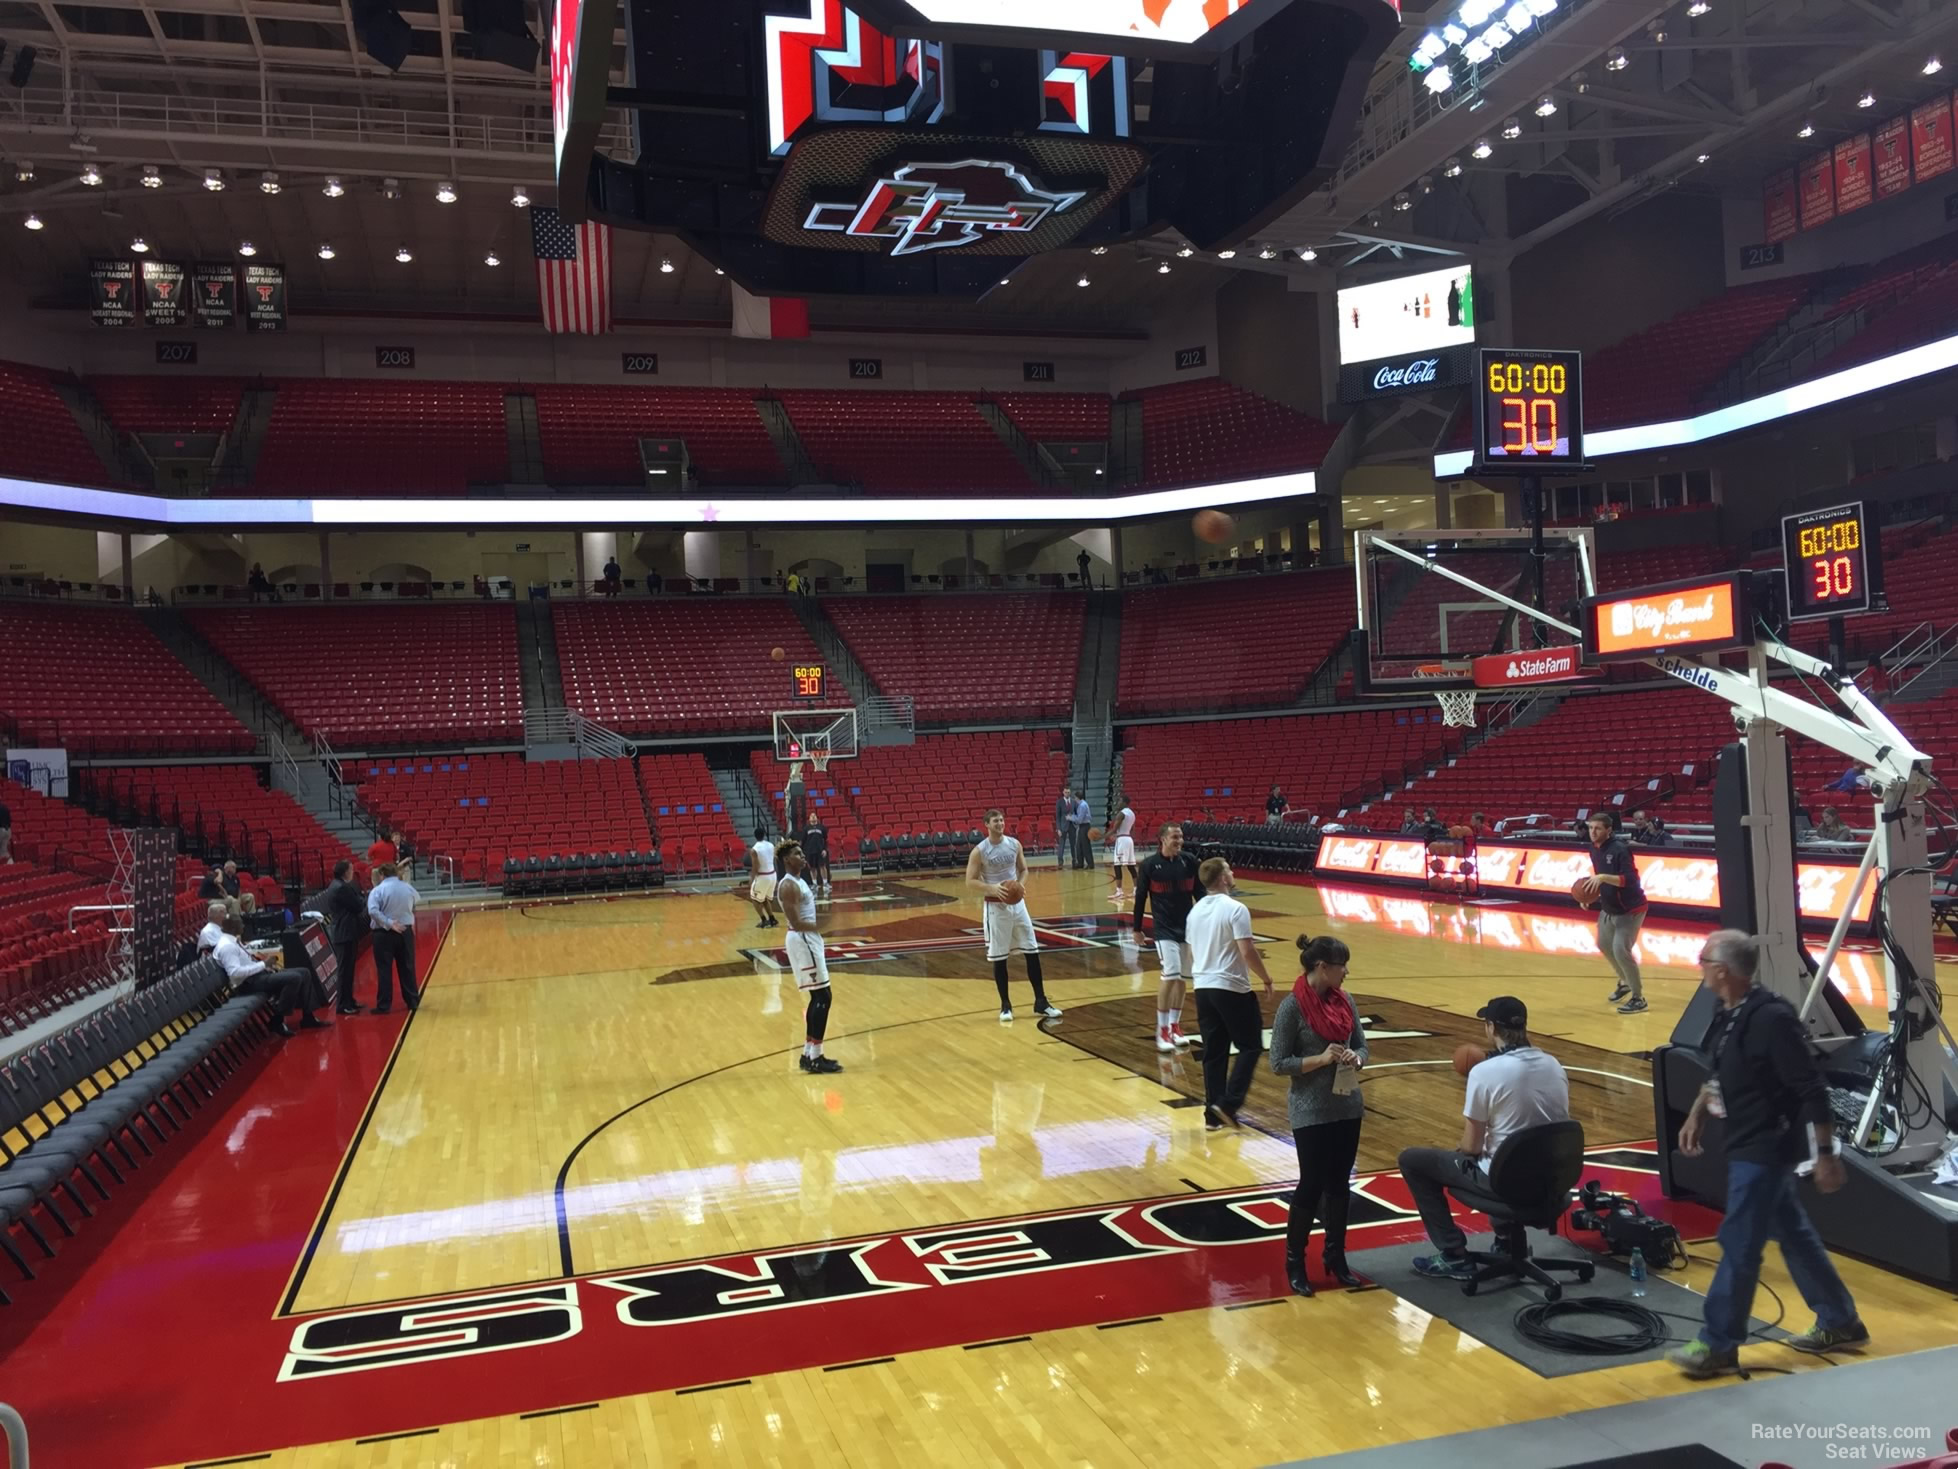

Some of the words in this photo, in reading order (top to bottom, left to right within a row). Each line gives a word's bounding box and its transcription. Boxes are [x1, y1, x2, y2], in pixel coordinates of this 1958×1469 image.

[1749, 246, 1775, 265] 213
[114, 262, 130, 271] TECH
[165, 264, 180, 272] TECH
[248, 267, 265, 275] TEXAS
[145, 309, 174, 317] SWEET
[161, 346, 191, 360] 207
[381, 351, 410, 365] 208
[1181, 351, 1201, 367] 212
[1505, 351, 1553, 359] DAKTRONICS
[627, 356, 654, 371] 209
[855, 362, 877, 376] 210
[1031, 366, 1047, 379] 211
[1489, 363, 1566, 394] 60:00
[1502, 398, 1557, 451] 30
[1798, 507, 1852, 524] DAKTRONICS
[1800, 520, 1860, 558] 60:00
[1815, 556, 1852, 598] 30
[795, 667, 821, 678] 60:00
[1655, 655, 1718, 692] schelde
[800, 678, 818, 694] 30
